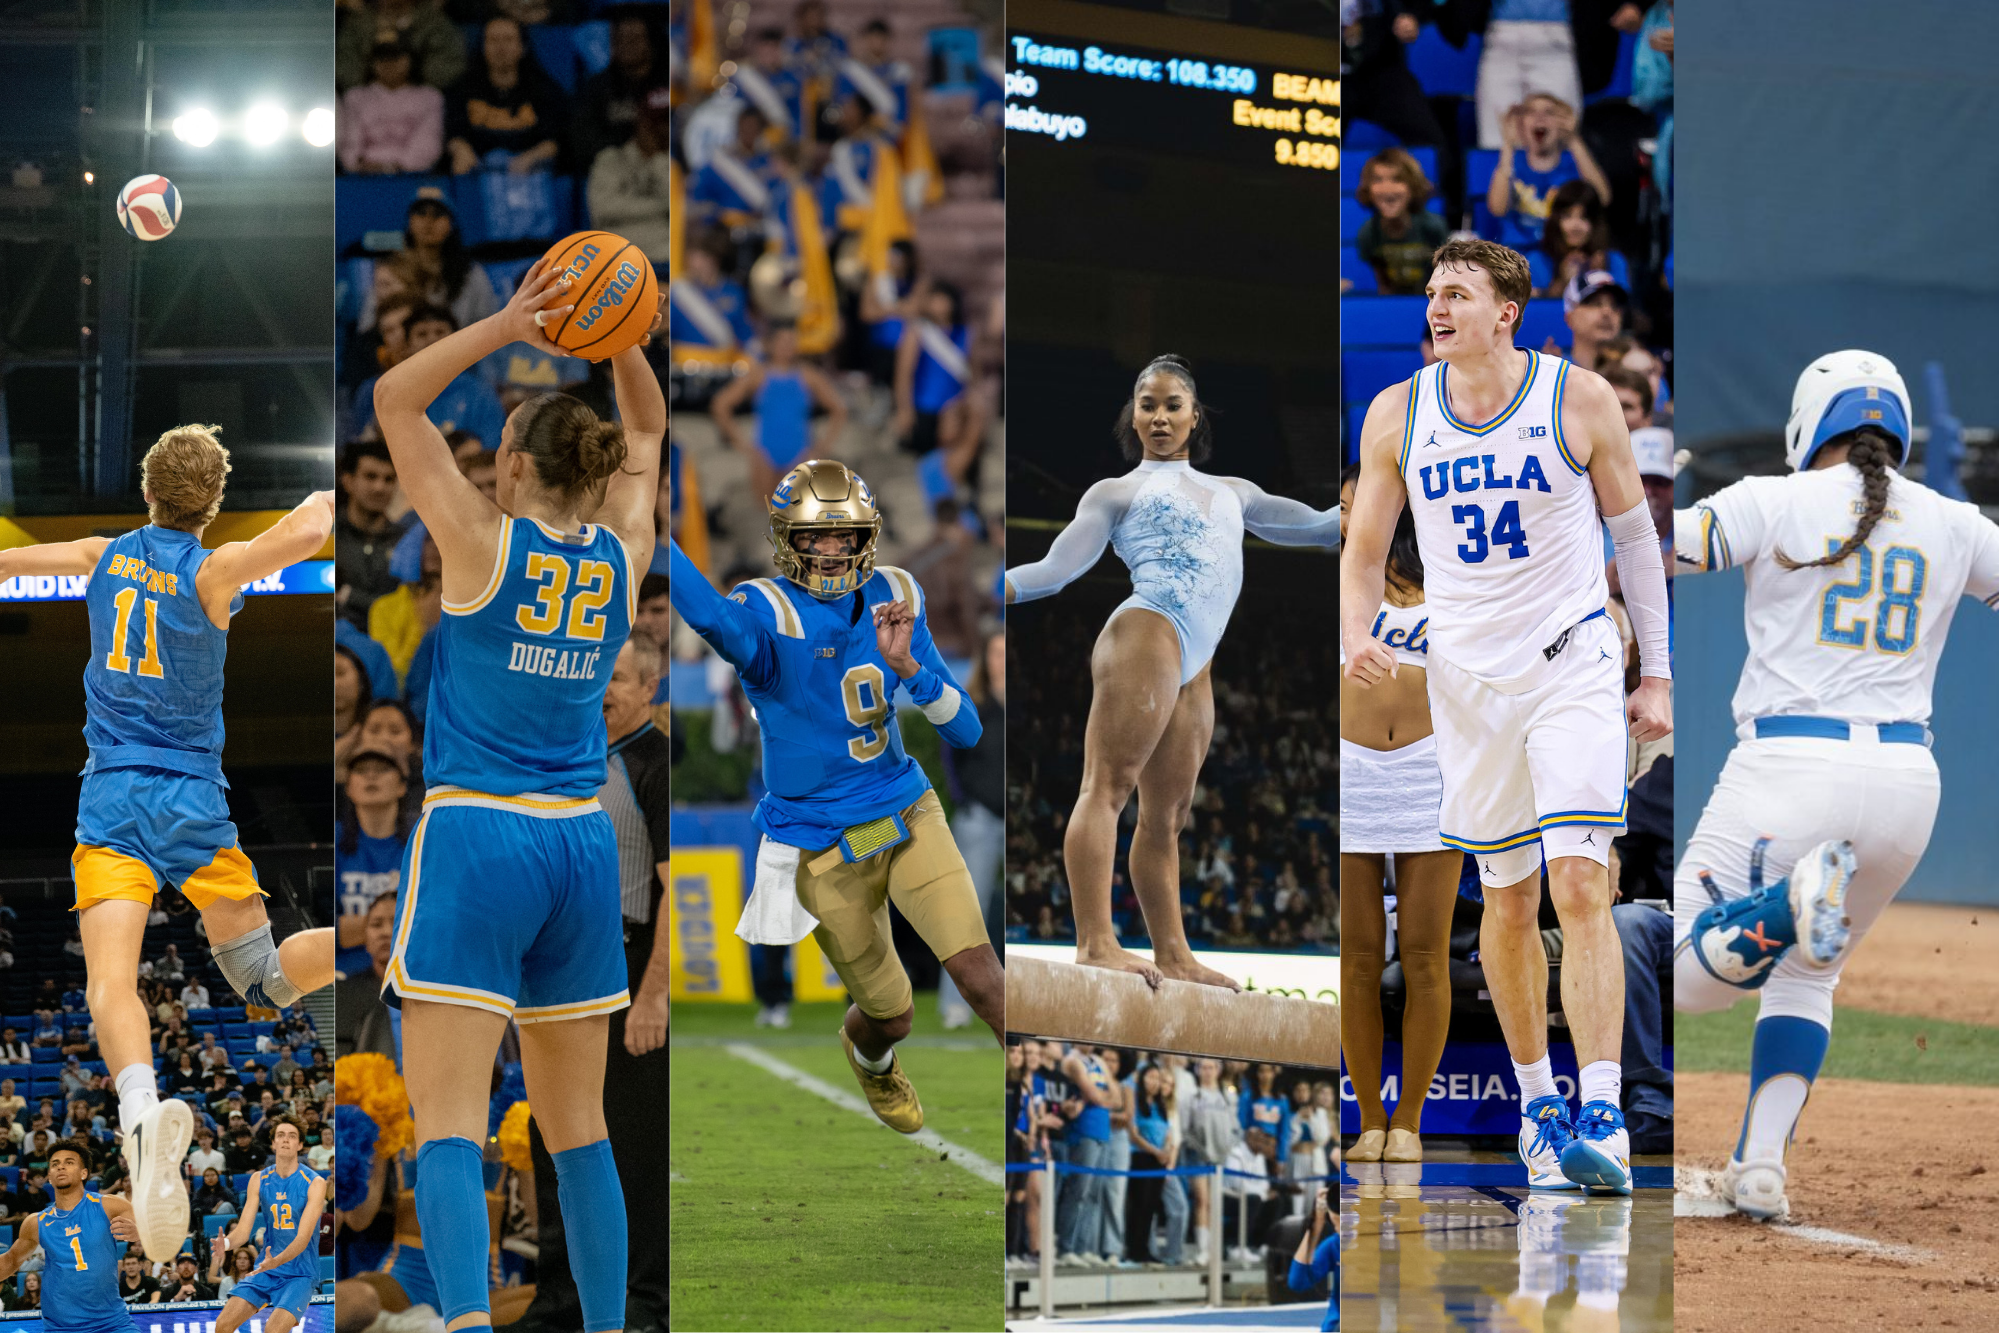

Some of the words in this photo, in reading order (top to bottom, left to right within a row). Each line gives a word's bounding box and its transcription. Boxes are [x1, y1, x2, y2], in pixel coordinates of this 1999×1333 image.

[1011, 36, 1079, 70] Team
[1083, 46, 1163, 82] Score:
[1233, 99, 1303, 133] Event
[575, 261, 641, 331] Wilson
[1419, 454, 1552, 501] UCLA
[1451, 500, 1530, 563] 34
[107, 554, 178, 596] BRUINS
[515, 551, 615, 641] 32
[1816, 535, 1929, 657] 28
[106, 586, 164, 680] 11
[508, 642, 600, 680] DUGALIĆ
[840, 662, 890, 764] 9
[270, 1203, 296, 1230] 12
[69, 1236, 88, 1272] 1
